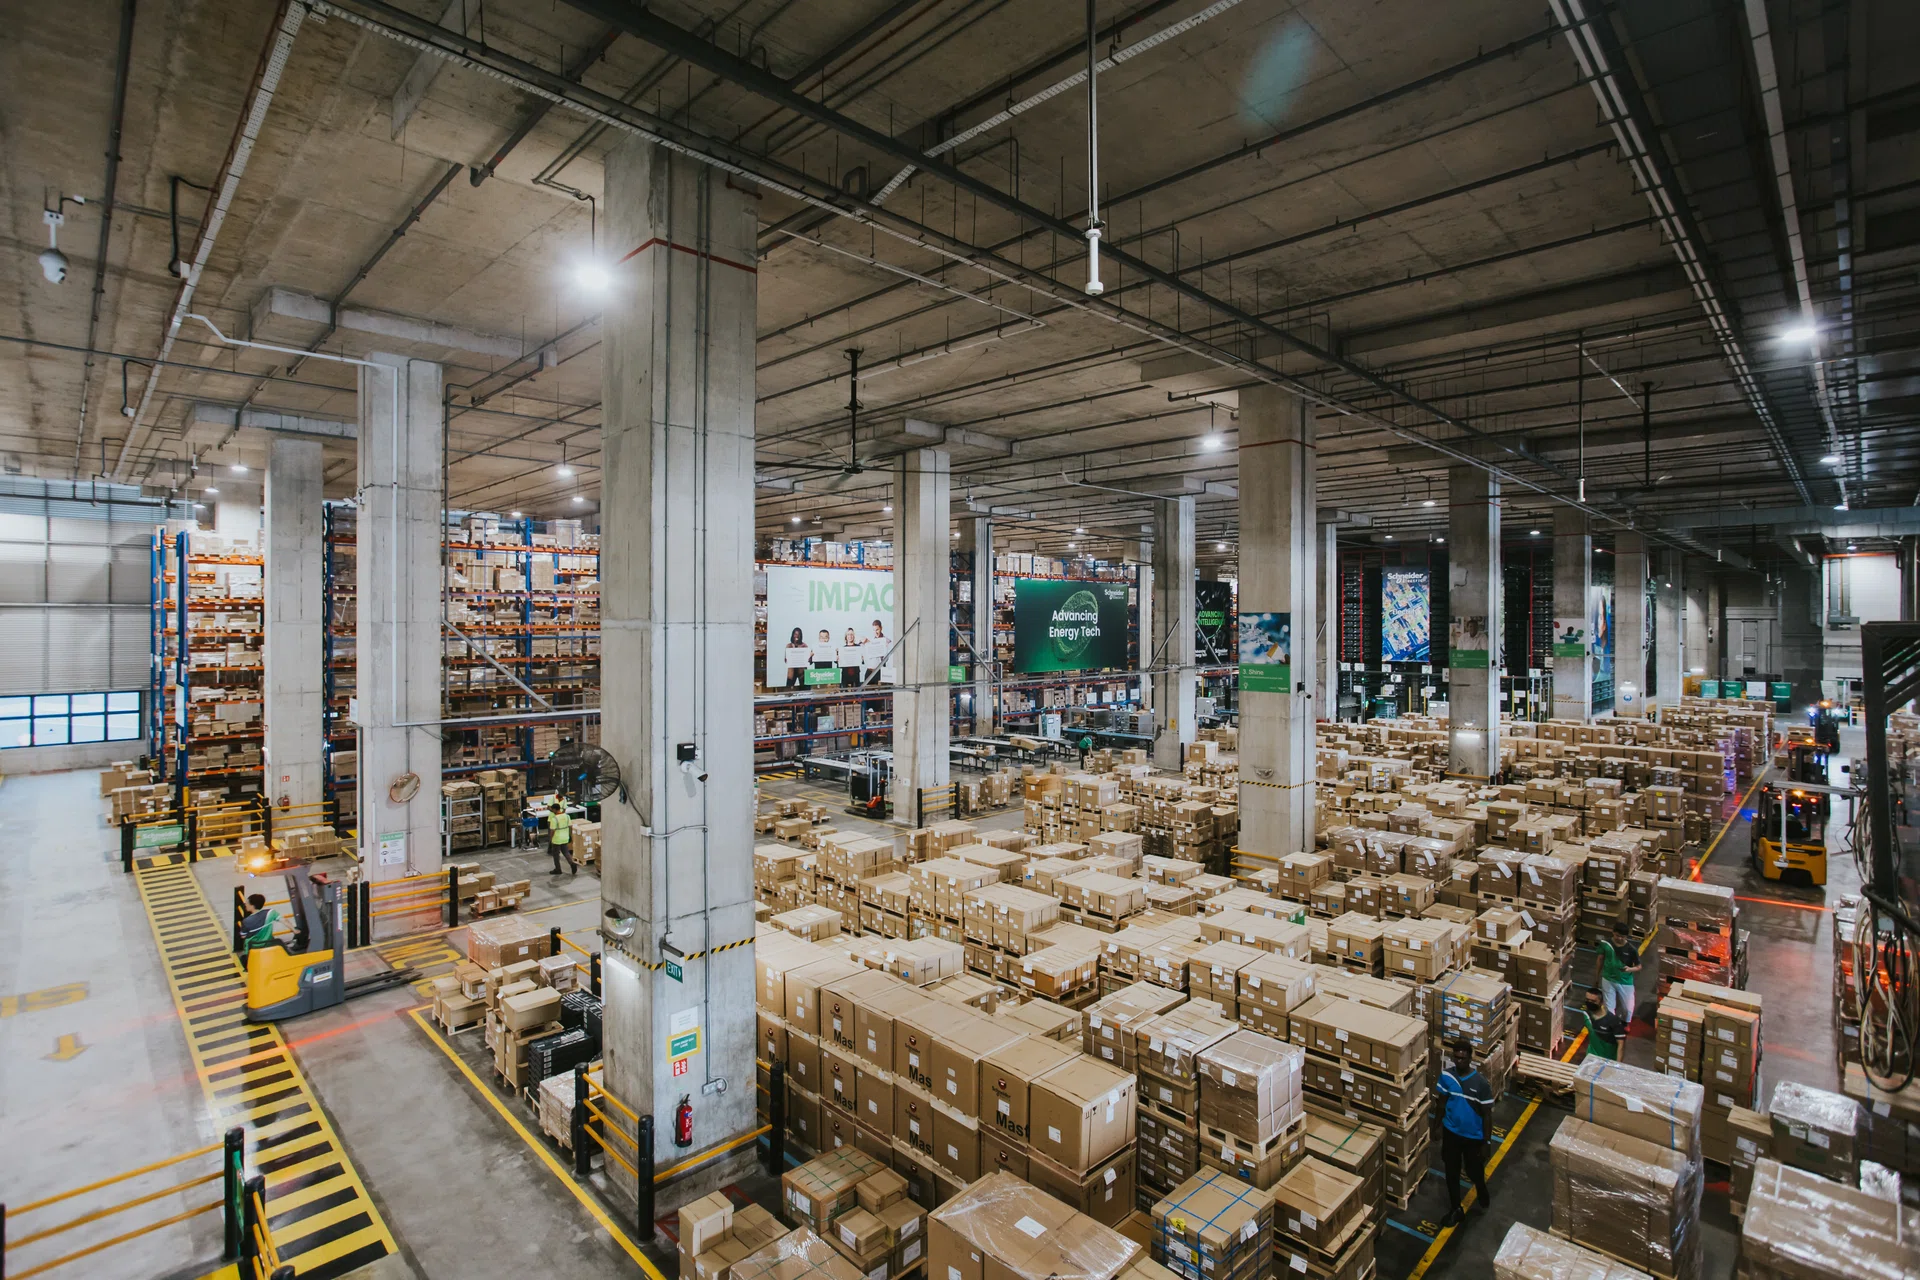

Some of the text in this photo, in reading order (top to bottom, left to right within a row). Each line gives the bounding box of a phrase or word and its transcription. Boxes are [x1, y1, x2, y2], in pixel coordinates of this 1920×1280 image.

[1387, 572, 1424, 583] Schneider
[808, 580, 894, 613] IMPAC
[1104, 588, 1125, 600] Schneider
[1052, 609, 1099, 624] Advancing
[1049, 625, 1100, 640] Energy Tech
[809, 671, 836, 681] Schneider
[667, 962, 678, 977] EXIT
[1416, 1219, 1439, 1236] 36
